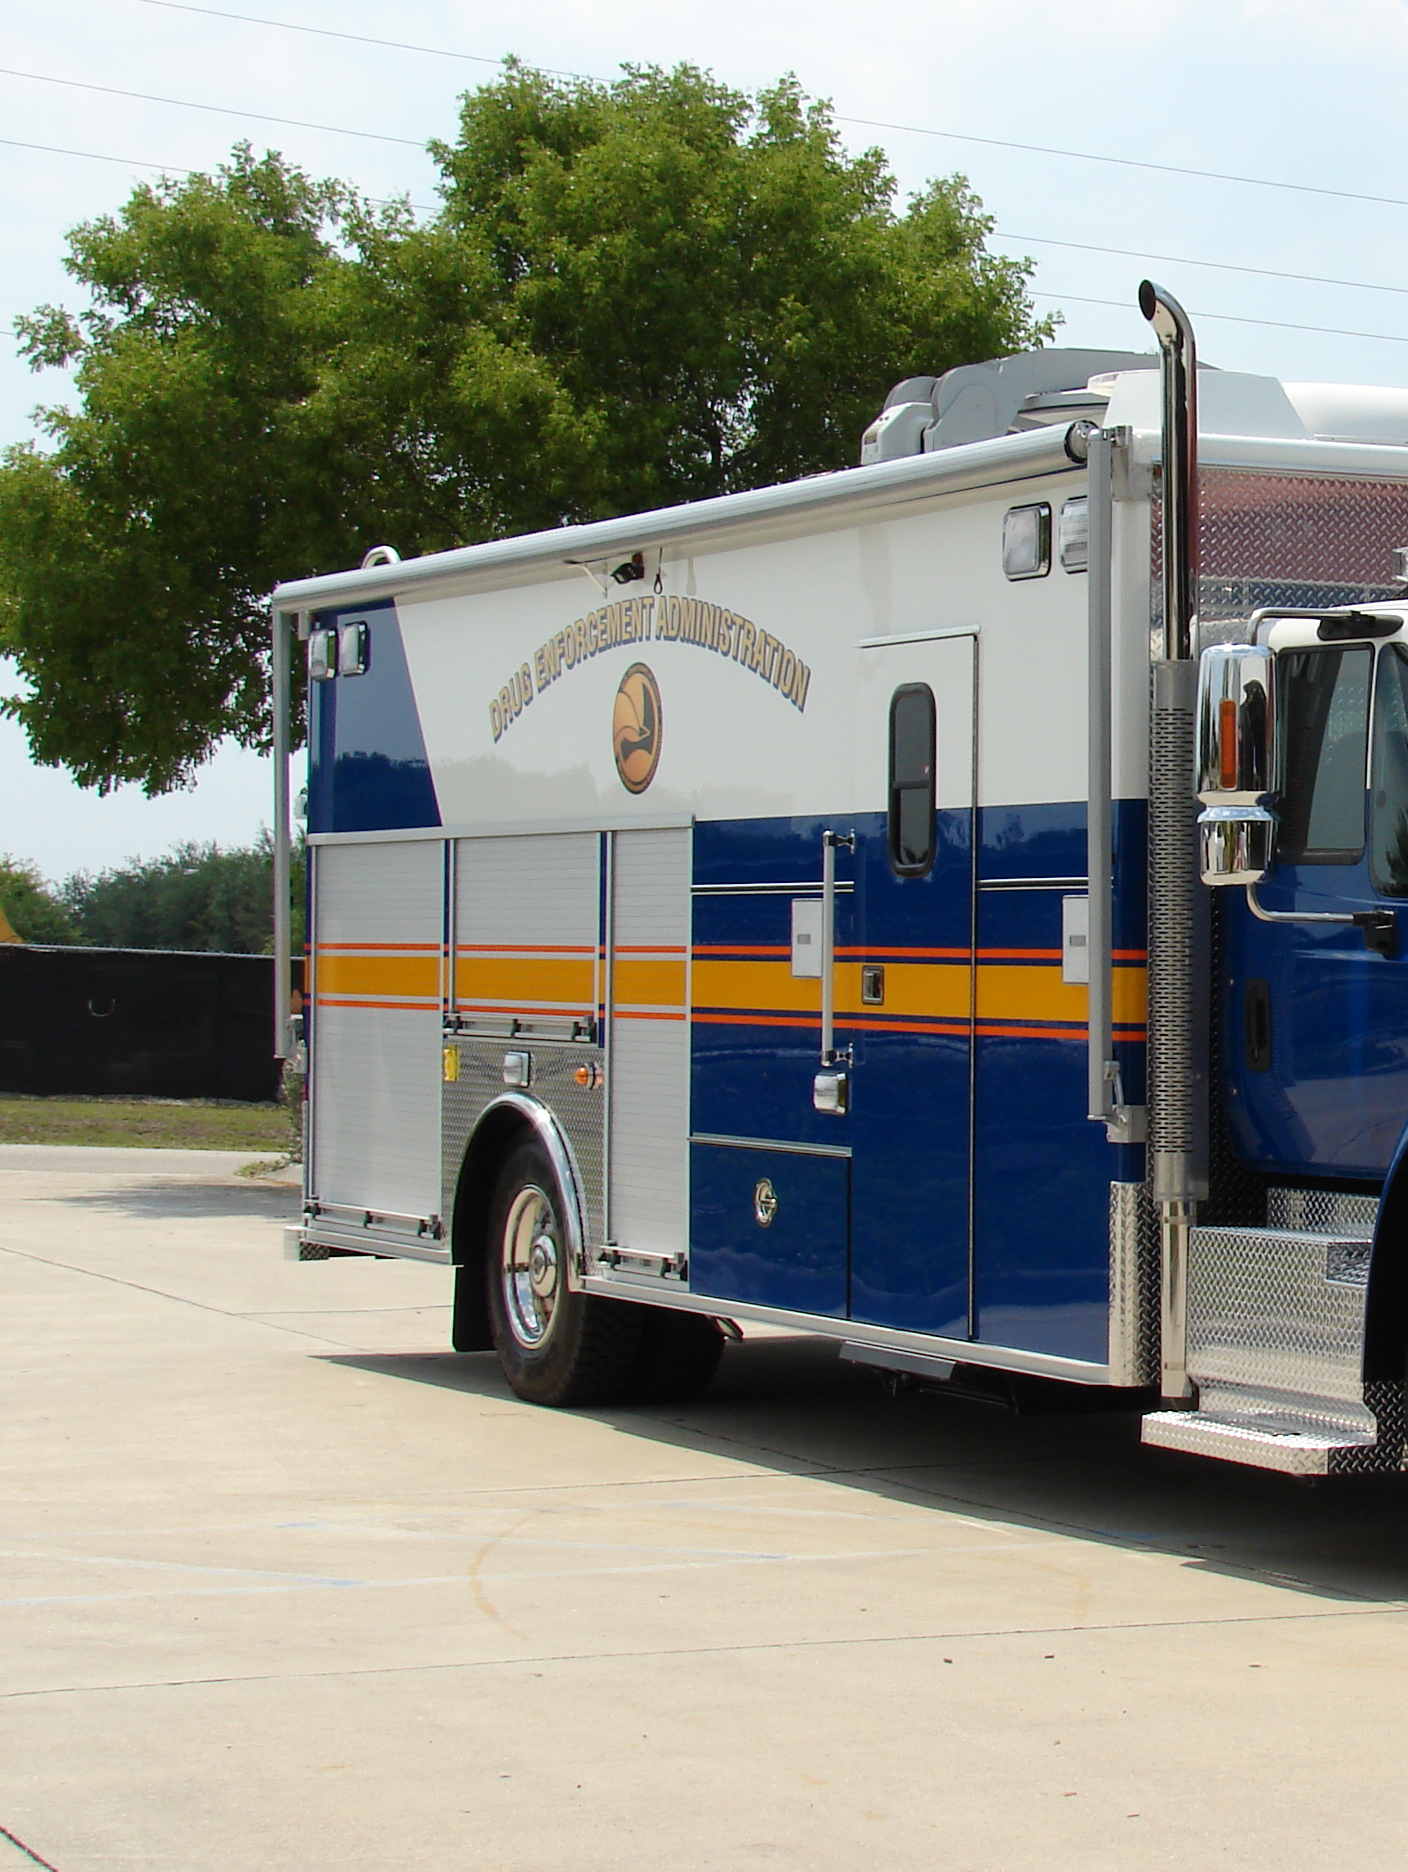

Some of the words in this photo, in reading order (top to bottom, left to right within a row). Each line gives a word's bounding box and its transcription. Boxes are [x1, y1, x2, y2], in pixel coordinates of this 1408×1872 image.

[489, 662, 534, 743] DRUG
[533, 596, 655, 694] ENFORCEMENT
[655, 595, 811, 714] ADMINISTRATION
